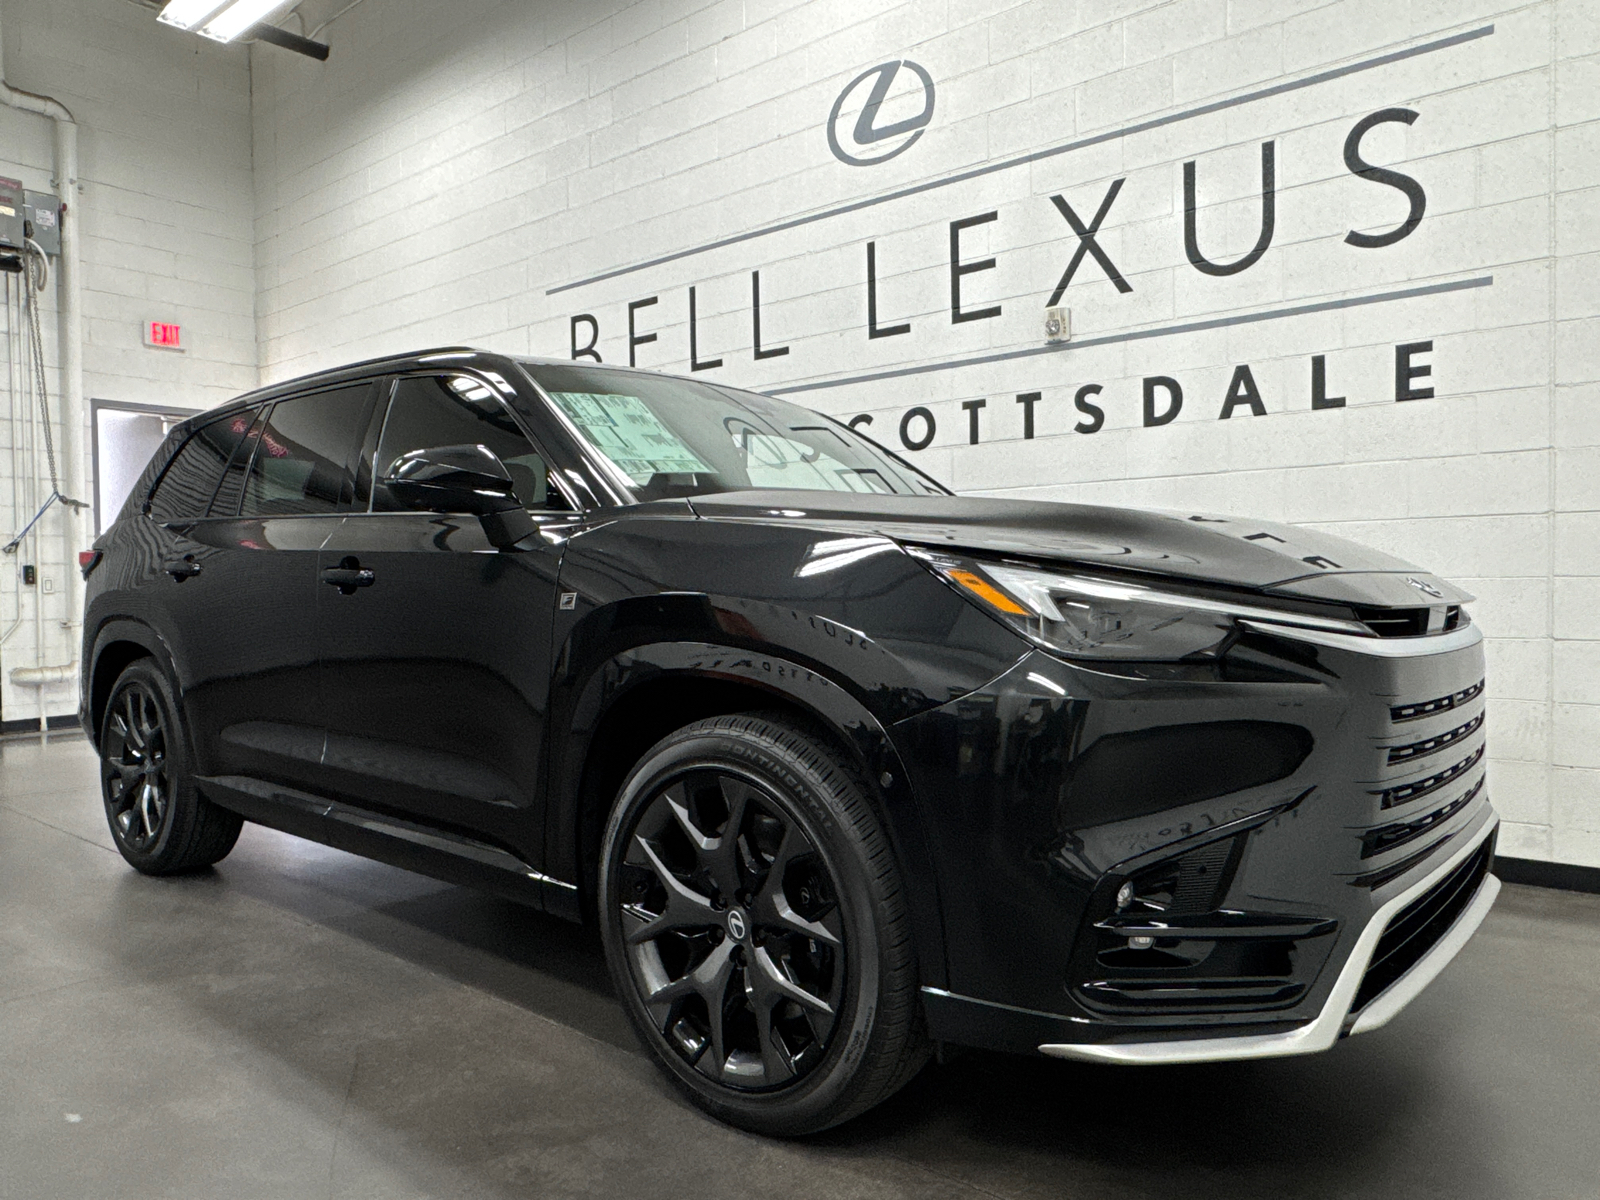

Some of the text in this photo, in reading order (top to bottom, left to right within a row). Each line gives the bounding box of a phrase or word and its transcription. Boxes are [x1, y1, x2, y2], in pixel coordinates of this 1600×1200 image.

[866, 107, 1427, 340] LEXUS
[151, 321, 181, 347] EXIT
[847, 340, 1435, 452] OTTSDALE
